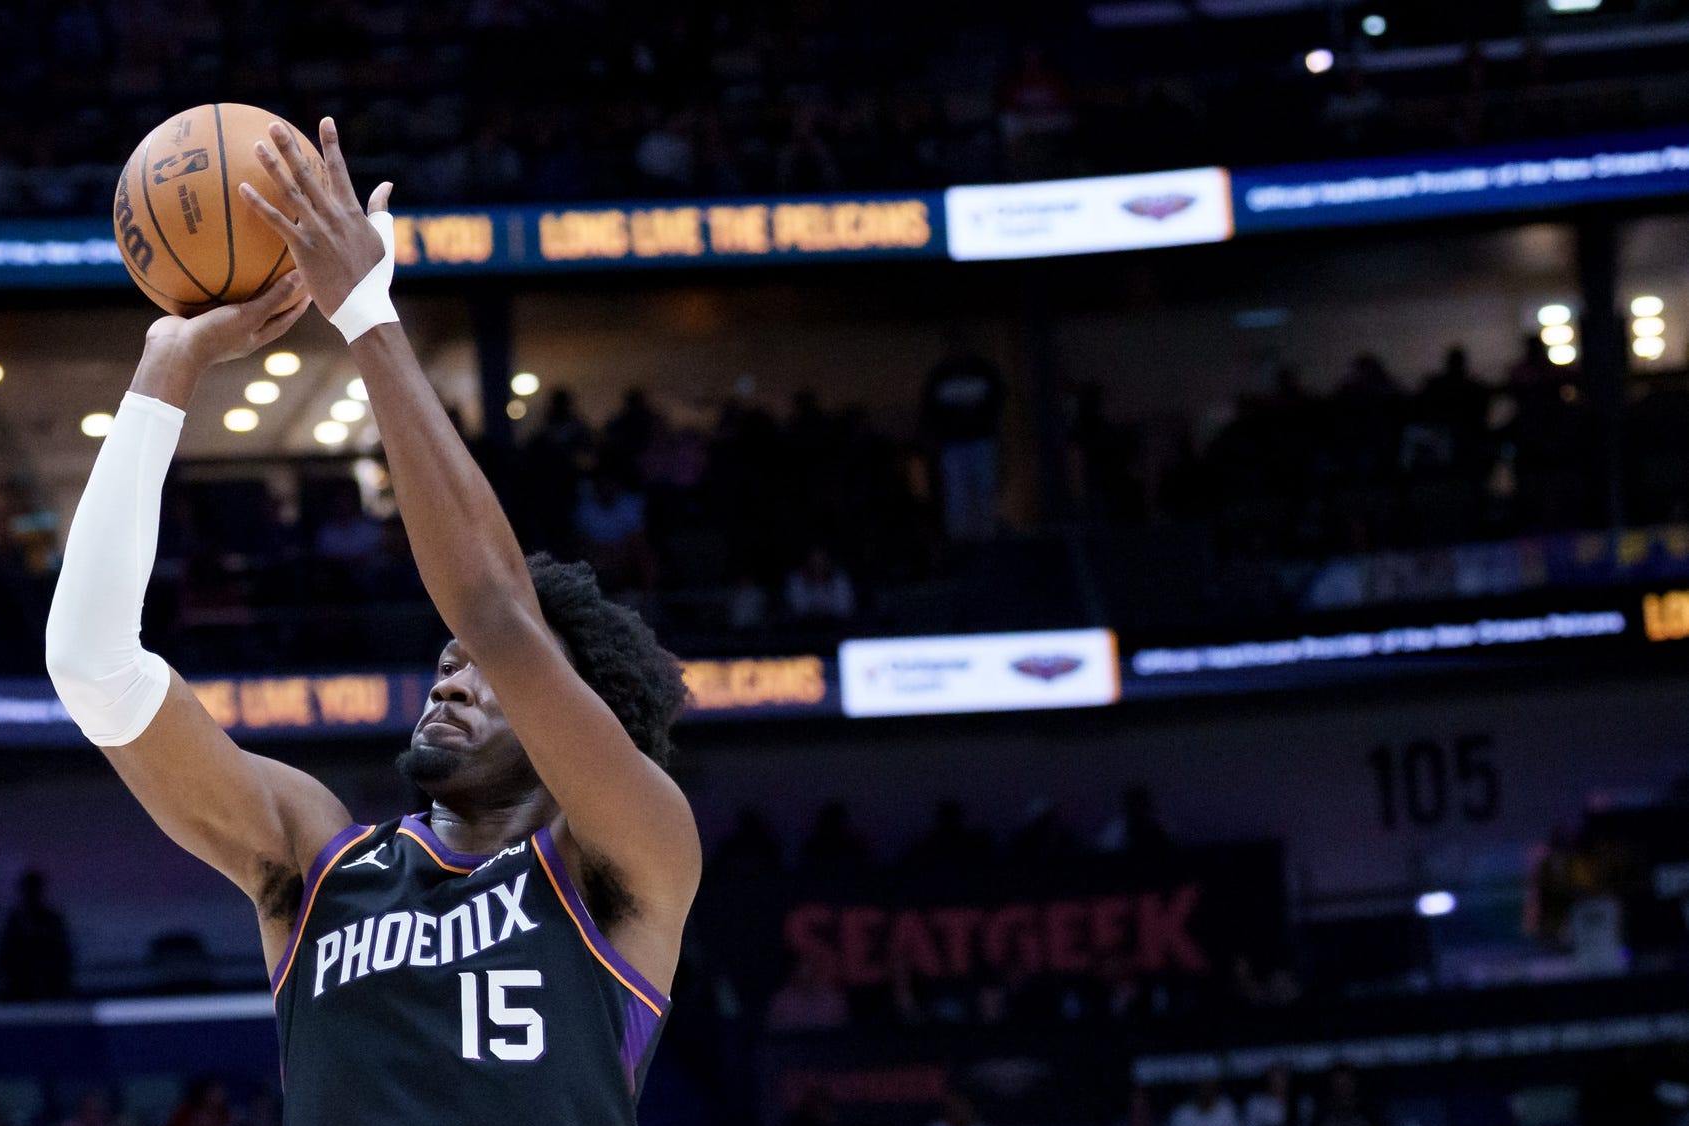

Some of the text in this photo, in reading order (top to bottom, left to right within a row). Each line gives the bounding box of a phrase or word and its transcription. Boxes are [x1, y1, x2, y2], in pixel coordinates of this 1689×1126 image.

[1369, 734, 1497, 830] 105
[313, 872, 541, 998] PHOENIX
[782, 880, 1210, 986] SEATGEEK
[459, 968, 546, 1062] 15
